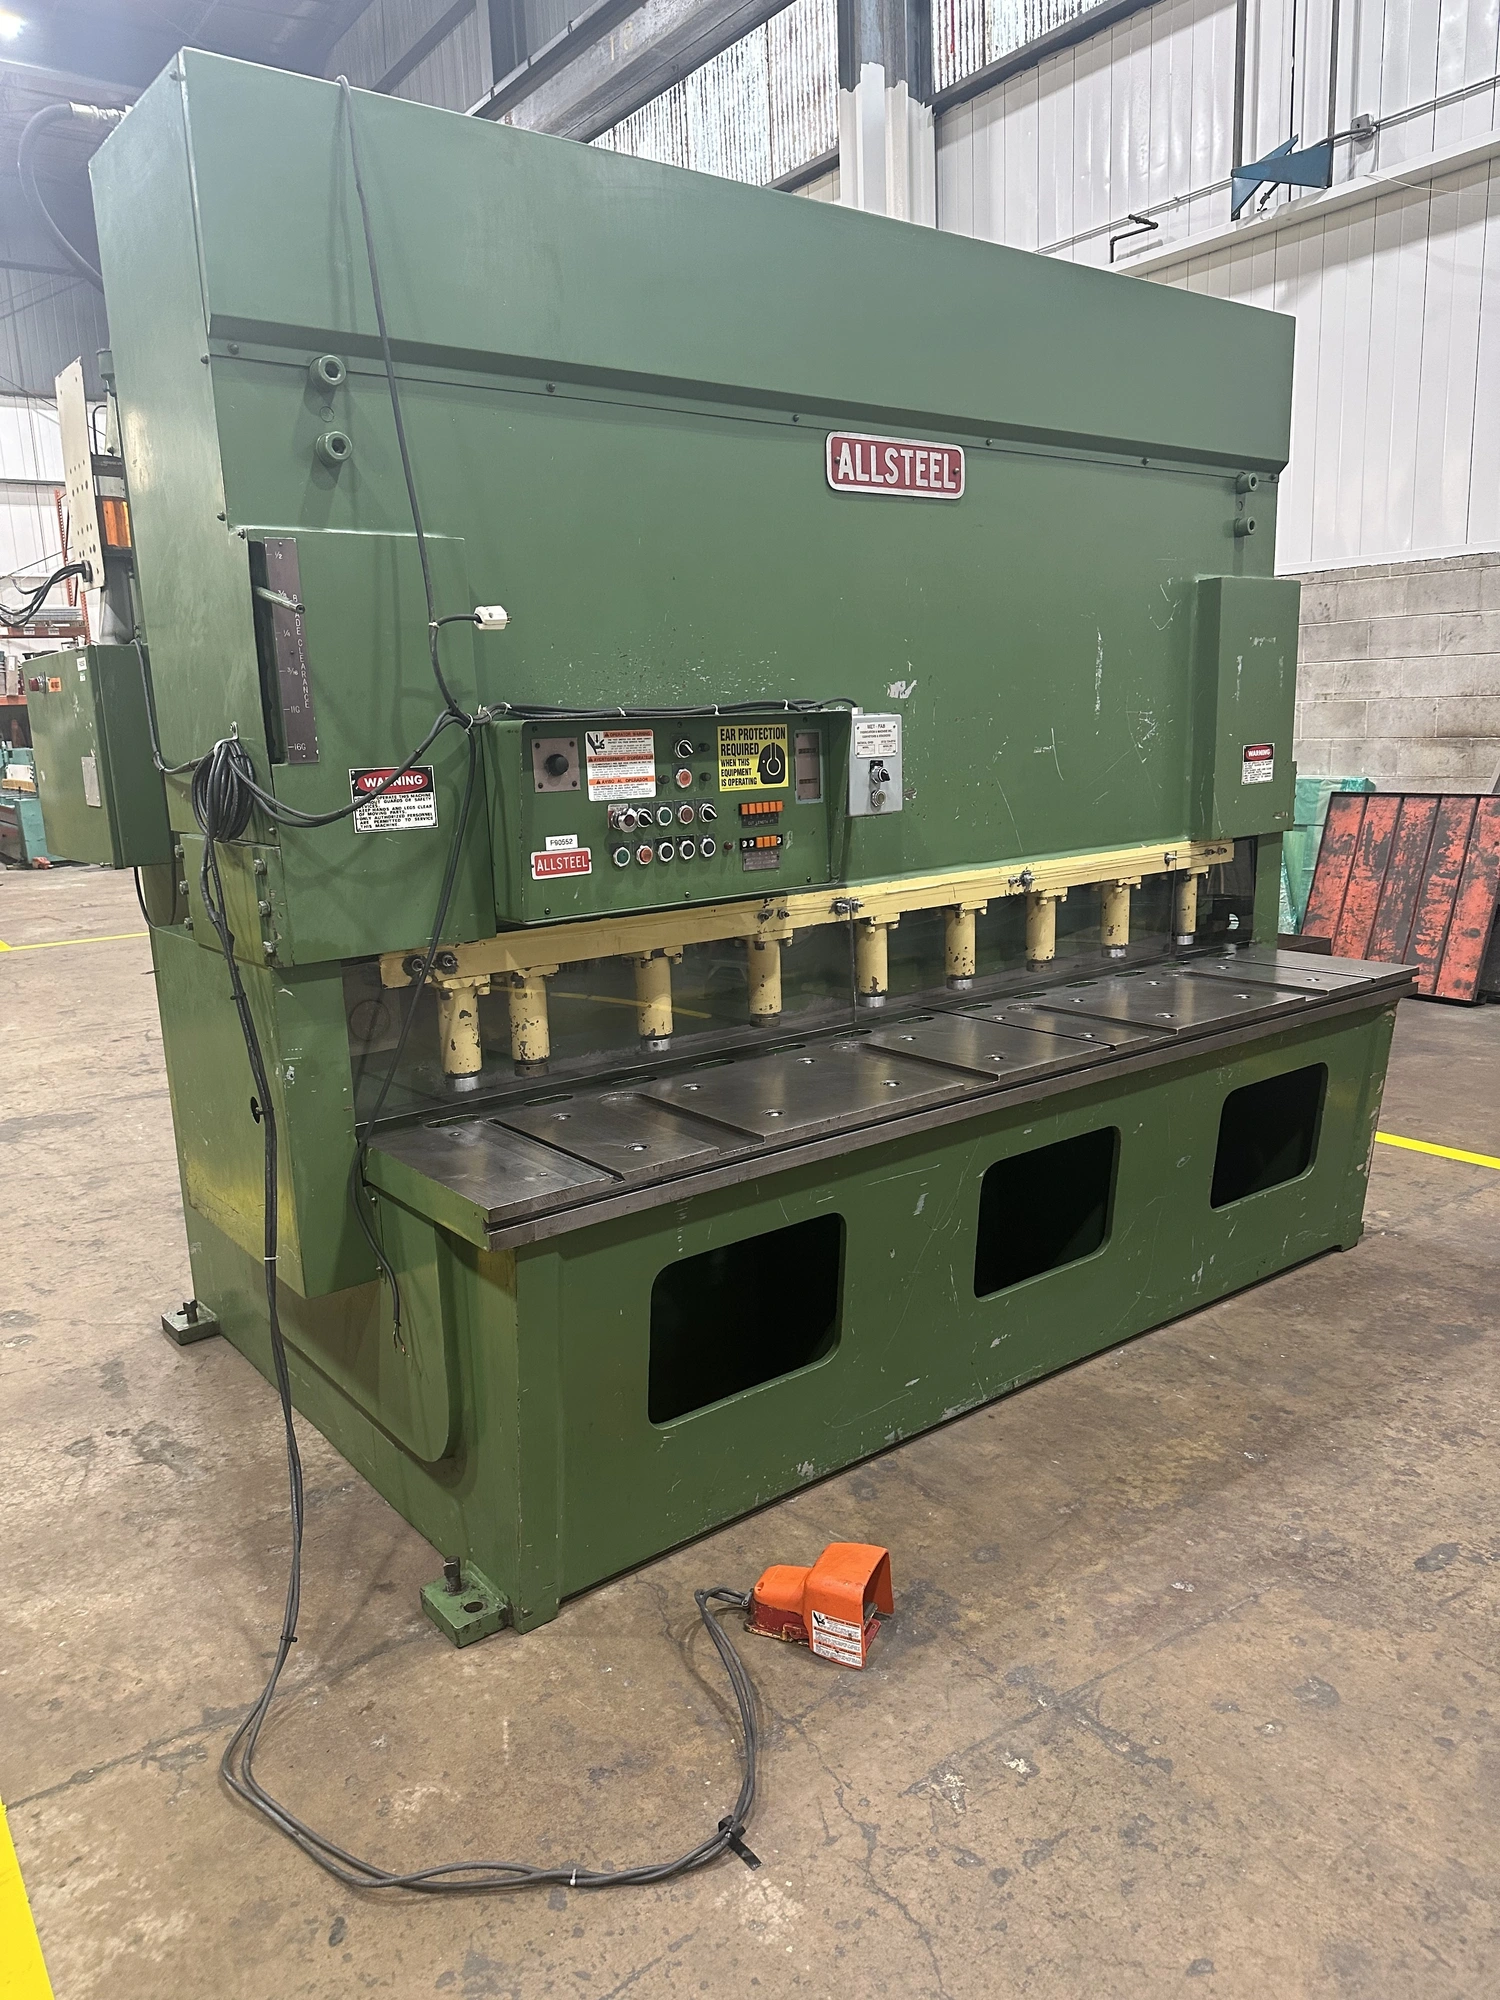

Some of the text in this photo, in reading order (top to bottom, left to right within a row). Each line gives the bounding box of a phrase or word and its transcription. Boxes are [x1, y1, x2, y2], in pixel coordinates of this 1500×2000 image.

[838, 442, 956, 489] ALLSTEEL
[292, 594, 310, 709] BADE CLEARANCE
[720, 727, 786, 741] EAR PROTECTION
[294, 743, 306, 751] 16G
[720, 743, 759, 757] REQUIRED
[721, 758, 750, 767] WHEN THIS
[721, 768, 752, 777] EQUIPMENT
[364, 774, 423, 788] WANING
[721, 777, 757, 786] IS OPERATING
[537, 855, 588, 872] ALLSTEEL
